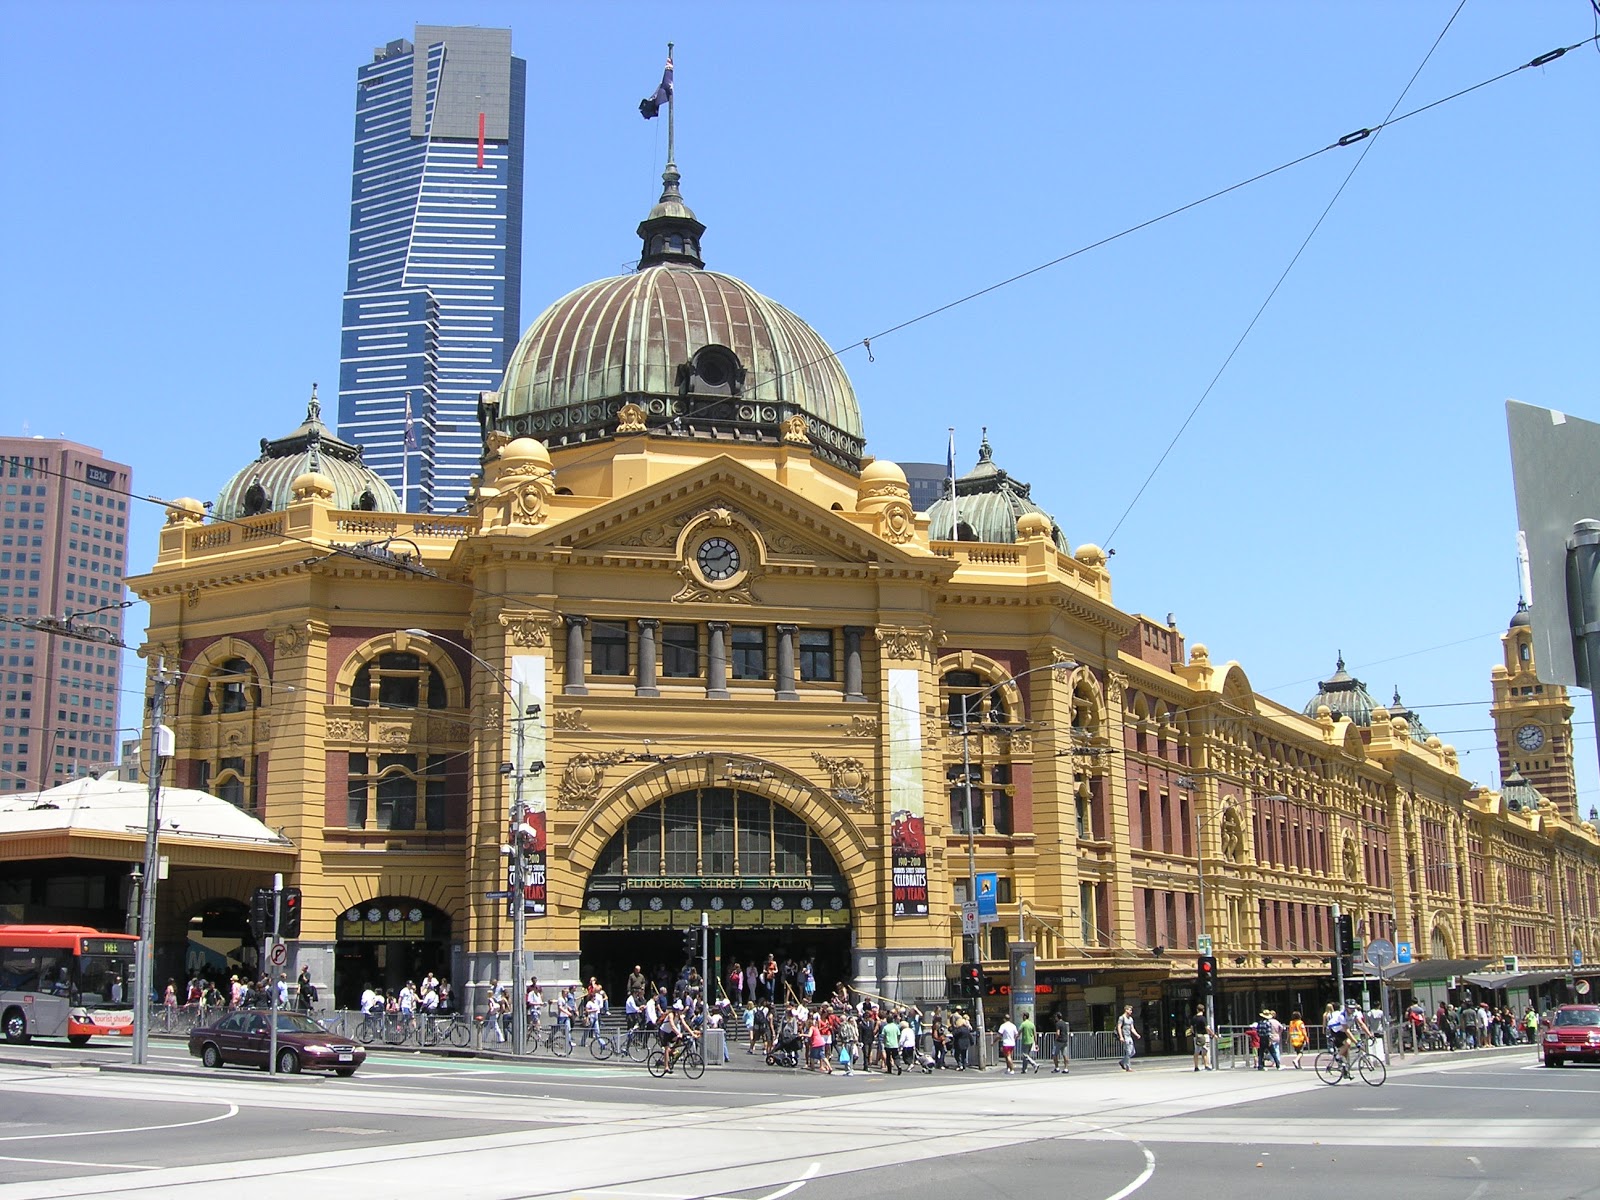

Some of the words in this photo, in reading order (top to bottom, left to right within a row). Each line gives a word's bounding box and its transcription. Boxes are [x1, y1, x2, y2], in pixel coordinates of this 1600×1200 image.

[89, 469, 107, 482] IBM
[627, 879, 686, 889] FLINDERS
[701, 879, 745, 889] STREET
[759, 879, 811, 890] STATION
[894, 874, 926, 887] CELEBRATES
[907, 888, 926, 900] YEARS
[104, 943, 118, 952] FREE
